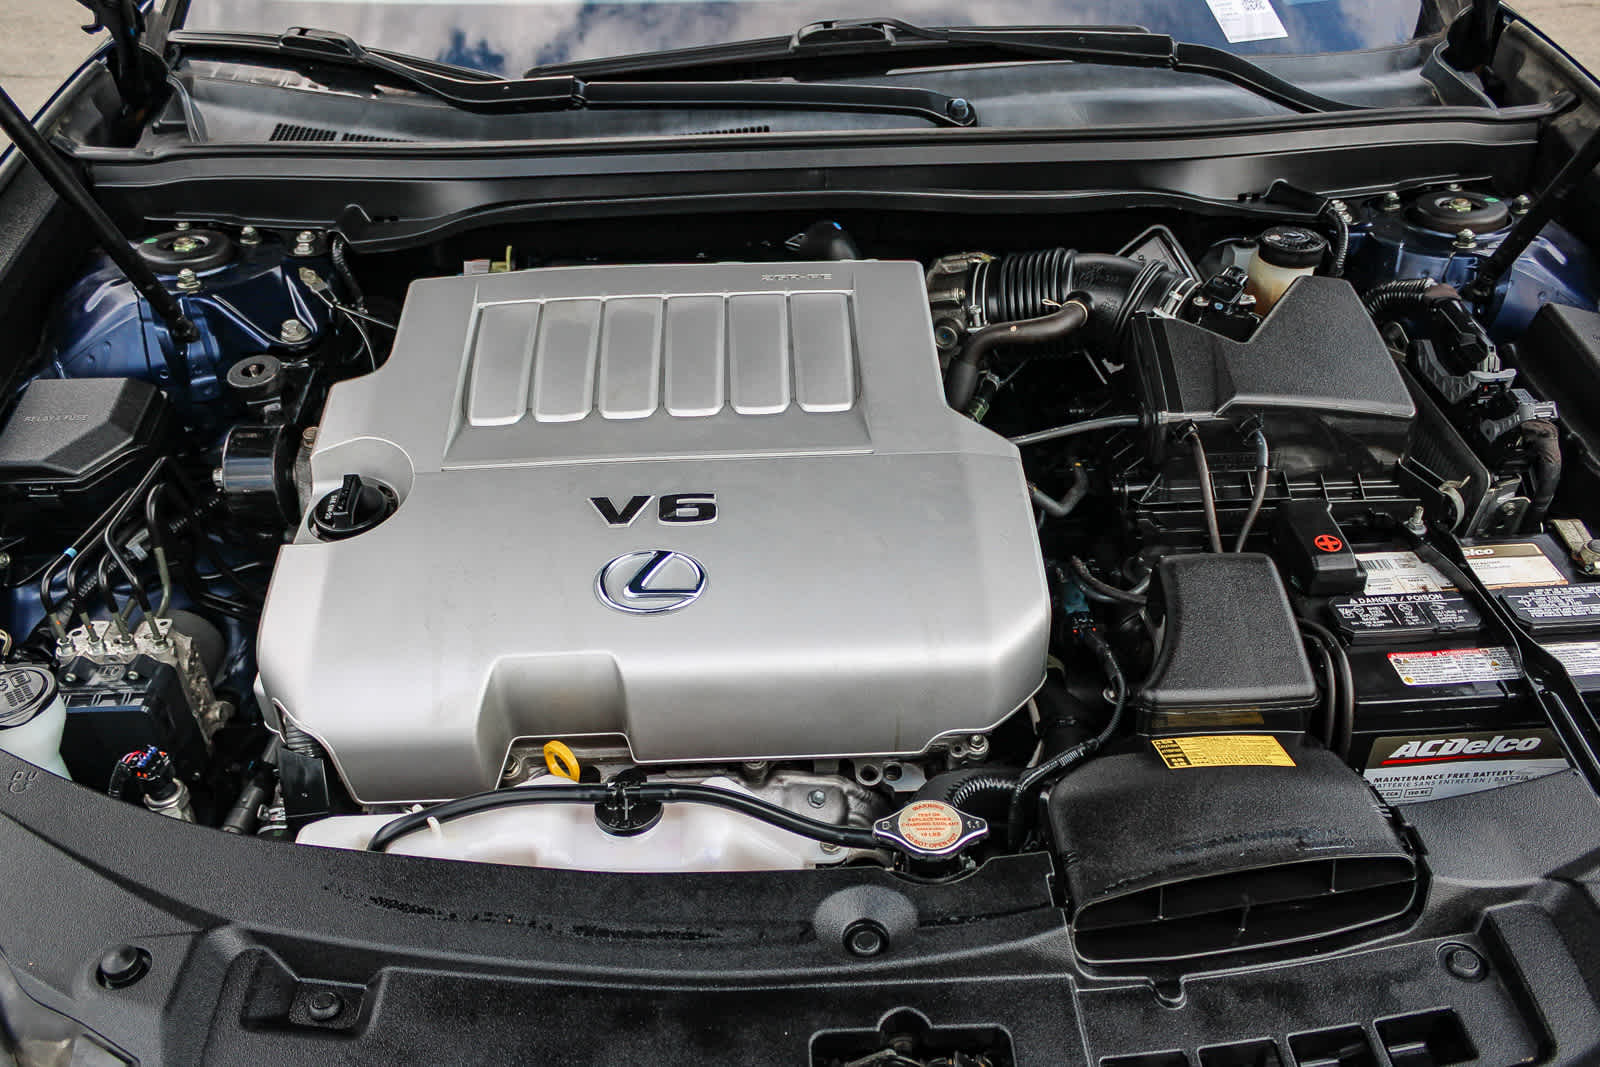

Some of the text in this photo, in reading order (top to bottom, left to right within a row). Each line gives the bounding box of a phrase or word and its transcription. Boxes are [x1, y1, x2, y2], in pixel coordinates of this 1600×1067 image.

[64, 414, 88, 422] FUSE
[587, 493, 718, 528] V6
[1359, 595, 1397, 604] DANGER
[1407, 593, 1444, 601] POISON
[1388, 735, 1543, 759] ACDelco
[1373, 773, 1445, 783] MAINTENANCE
[912, 803, 944, 811] WARNING
